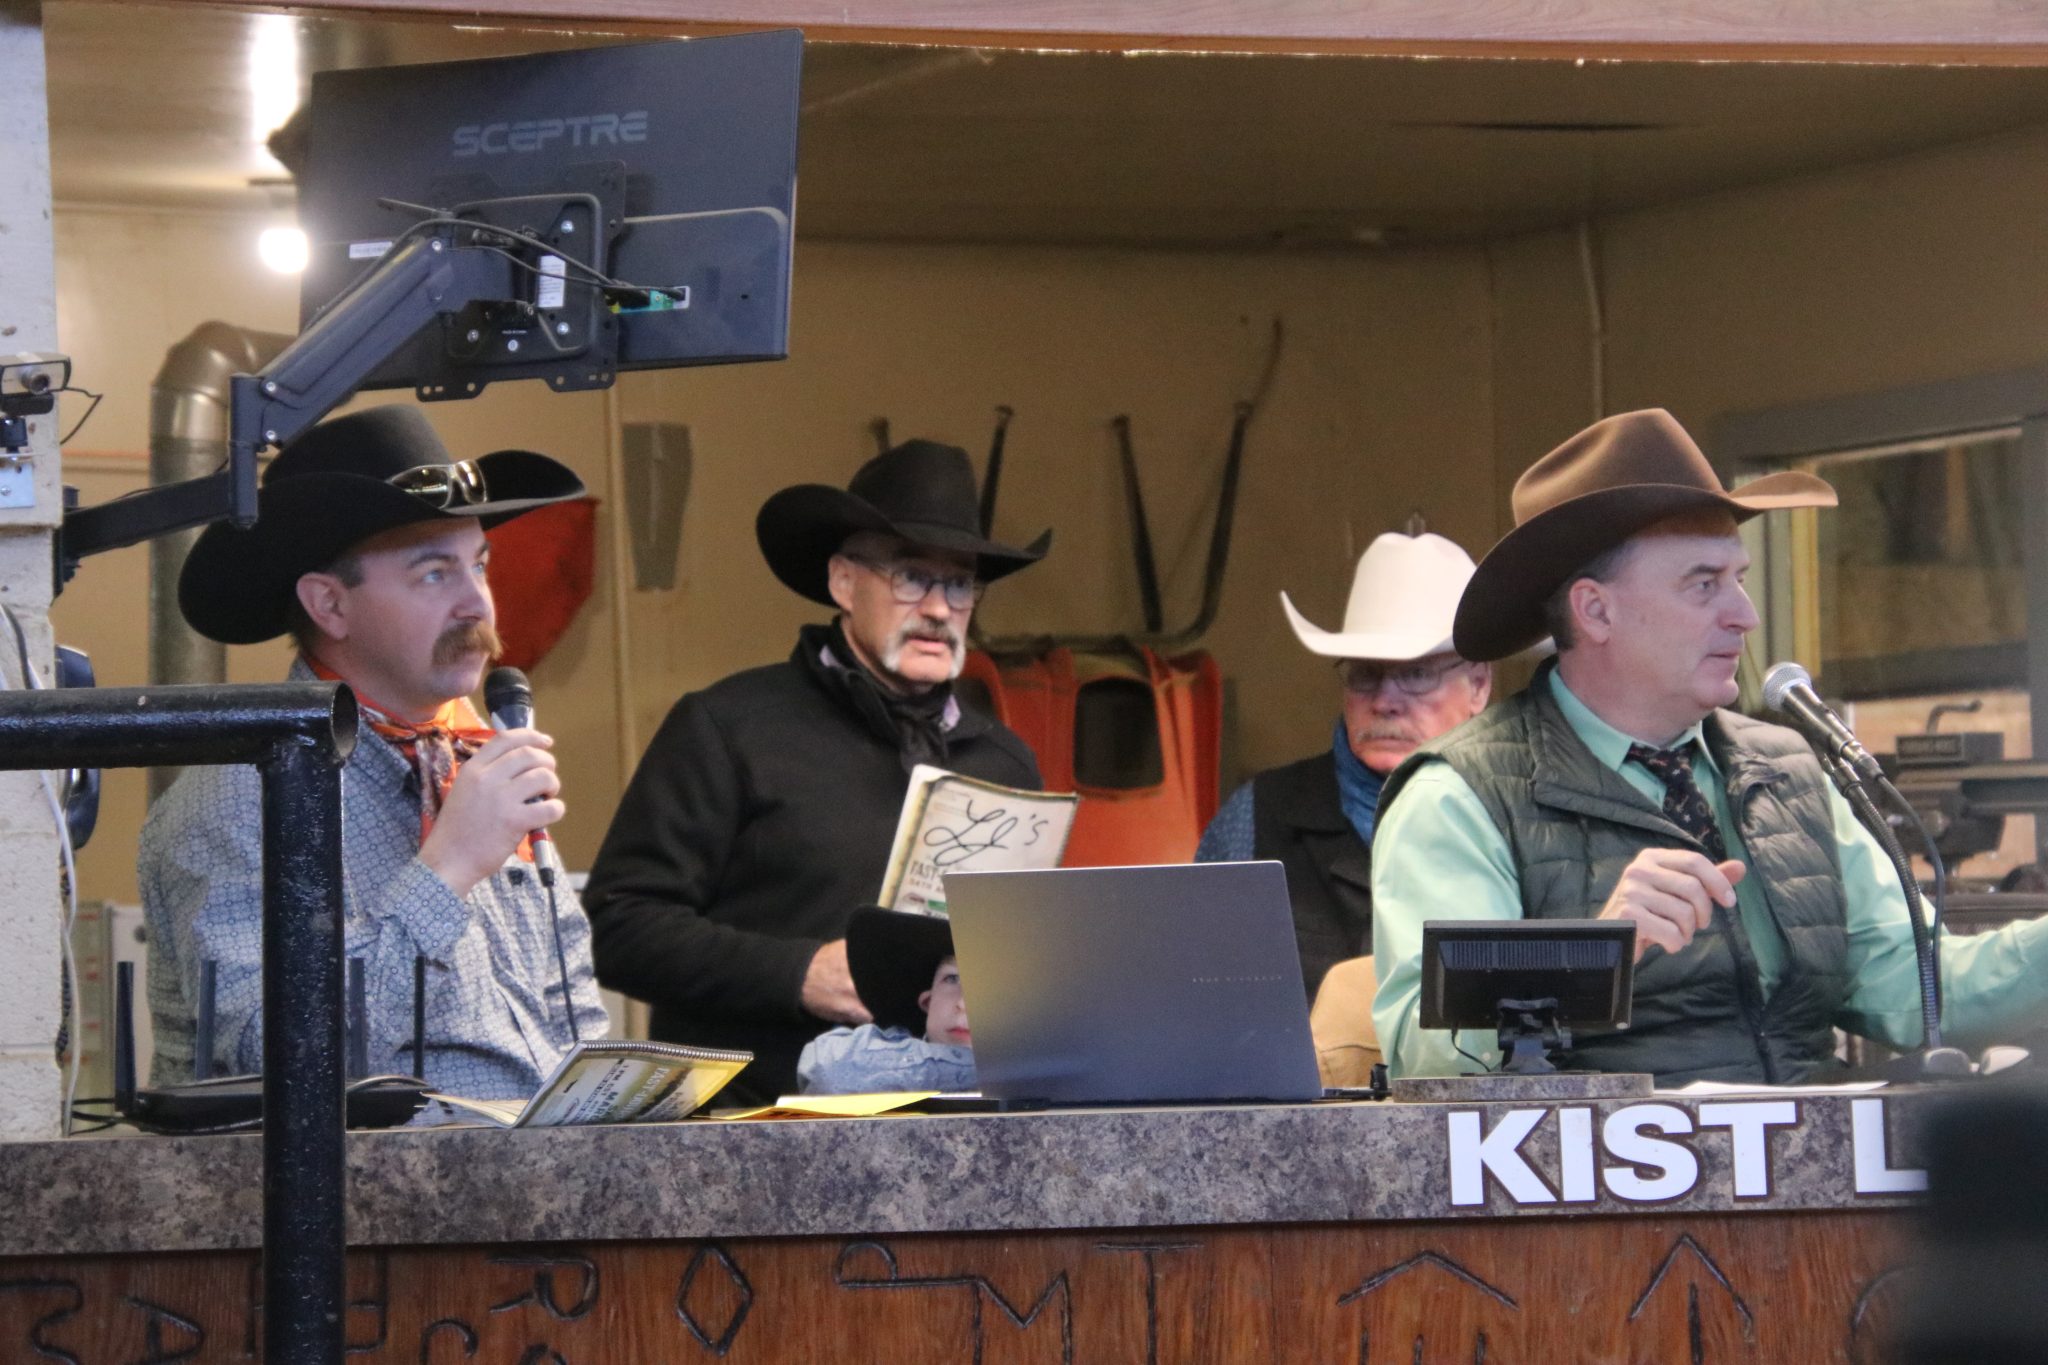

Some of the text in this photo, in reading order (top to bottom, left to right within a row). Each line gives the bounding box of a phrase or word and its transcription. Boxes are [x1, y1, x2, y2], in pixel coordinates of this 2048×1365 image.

[452, 110, 648, 157] SCEPTRE
[910, 860, 946, 878] FAST-
[1447, 1100, 1797, 1206] KIST
